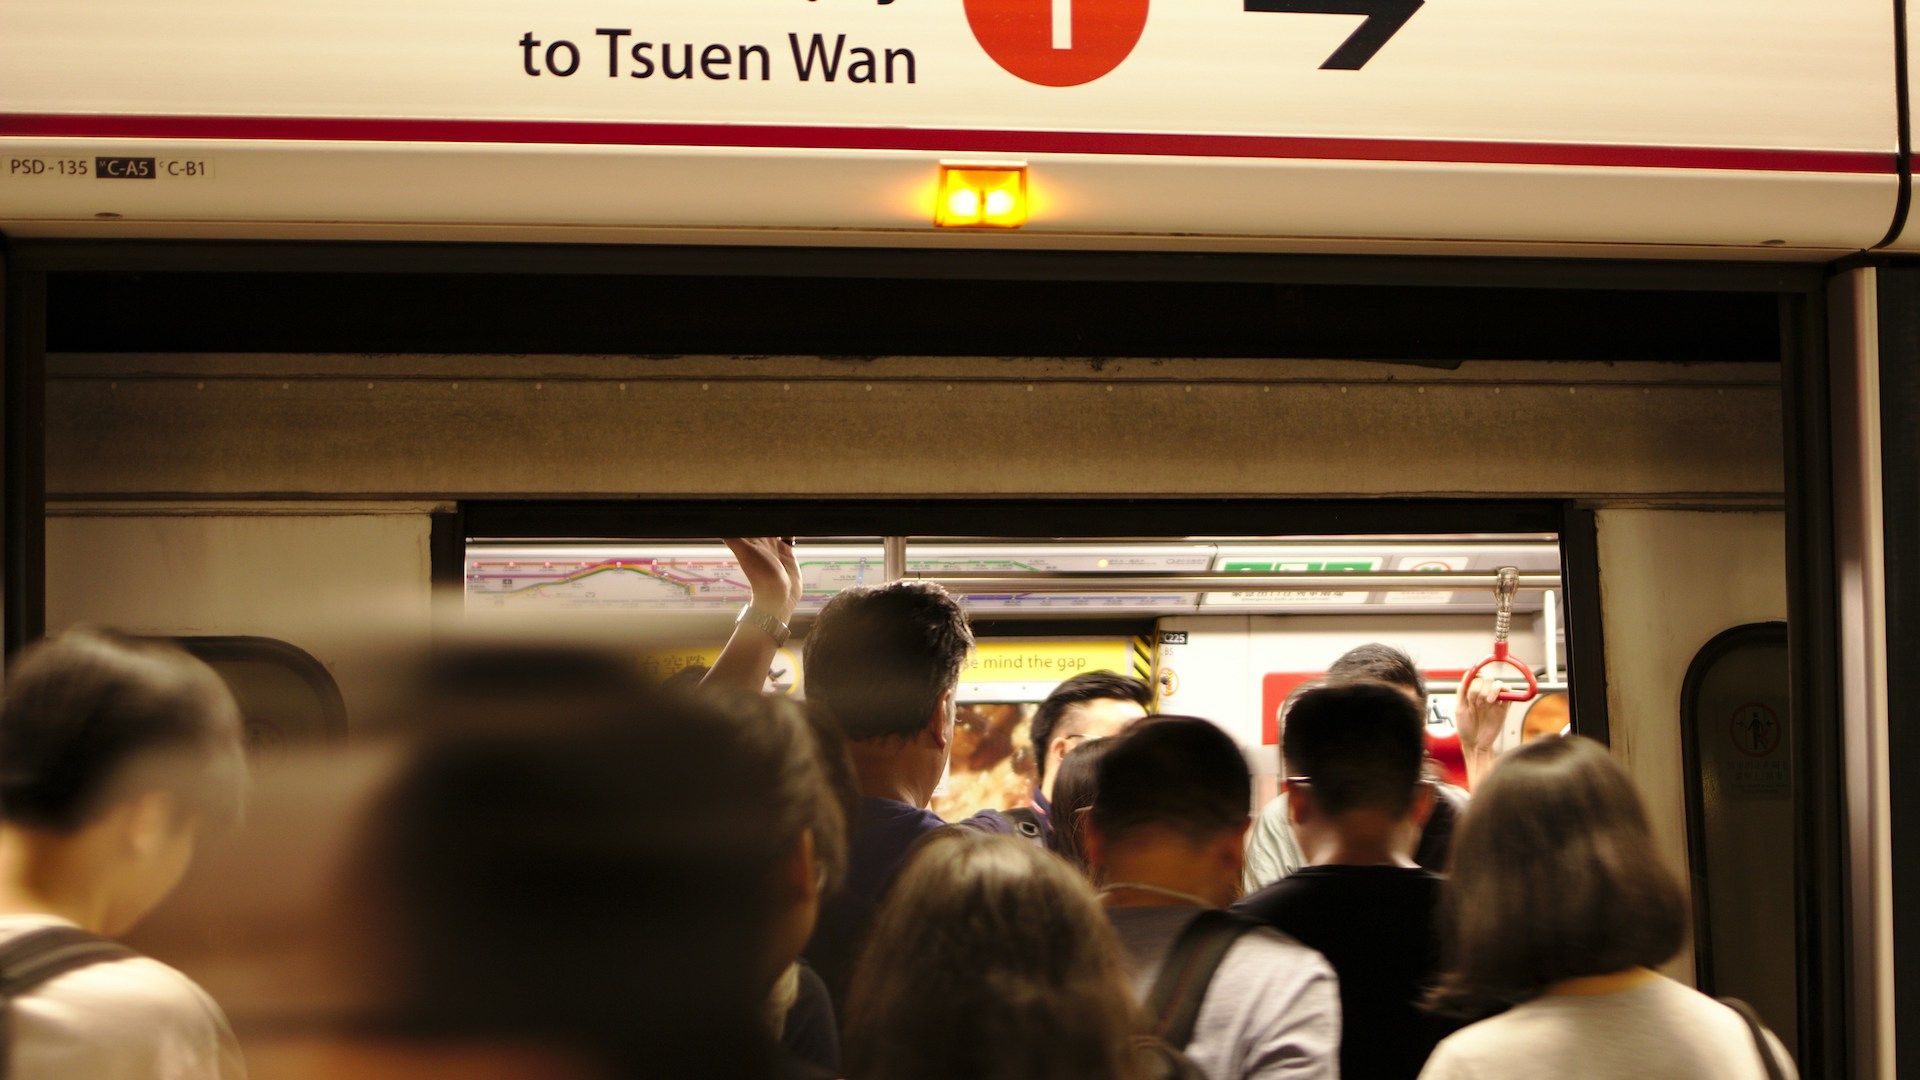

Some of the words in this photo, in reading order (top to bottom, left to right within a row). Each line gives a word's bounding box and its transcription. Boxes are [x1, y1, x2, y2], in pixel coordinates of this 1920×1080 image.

[519, 31, 581, 78] to
[596, 28, 770, 81] Tsuen
[788, 32, 917, 84] Wan
[984, 655, 1022, 669] mind
[1028, 655, 1053, 669] the
[1057, 656, 1086, 671] gap
